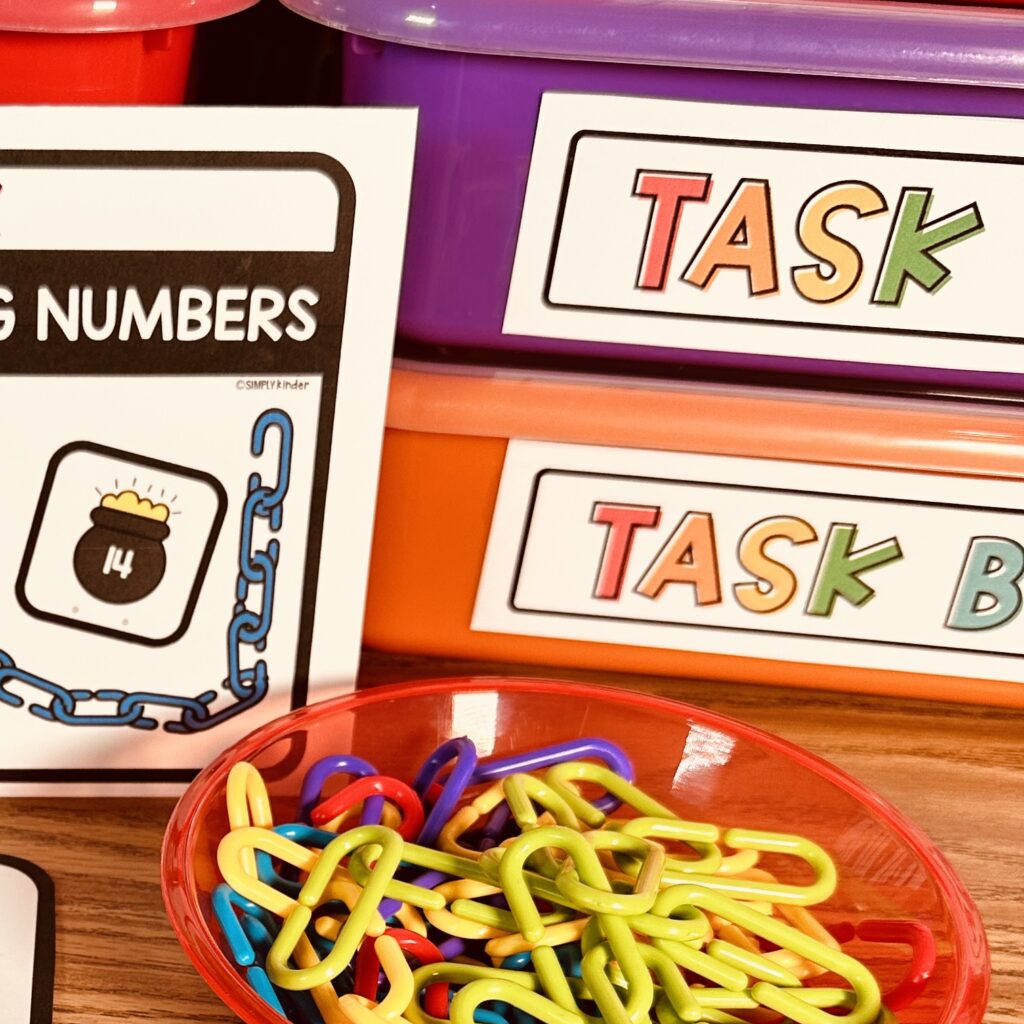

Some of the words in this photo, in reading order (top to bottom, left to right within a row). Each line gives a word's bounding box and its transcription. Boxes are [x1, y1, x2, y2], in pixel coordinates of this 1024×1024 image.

[631, 168, 985, 308] TASK
[36, 284, 319, 342] NUMBERS
[102, 544, 134, 579] 14
[590, 501, 904, 618] TASK
